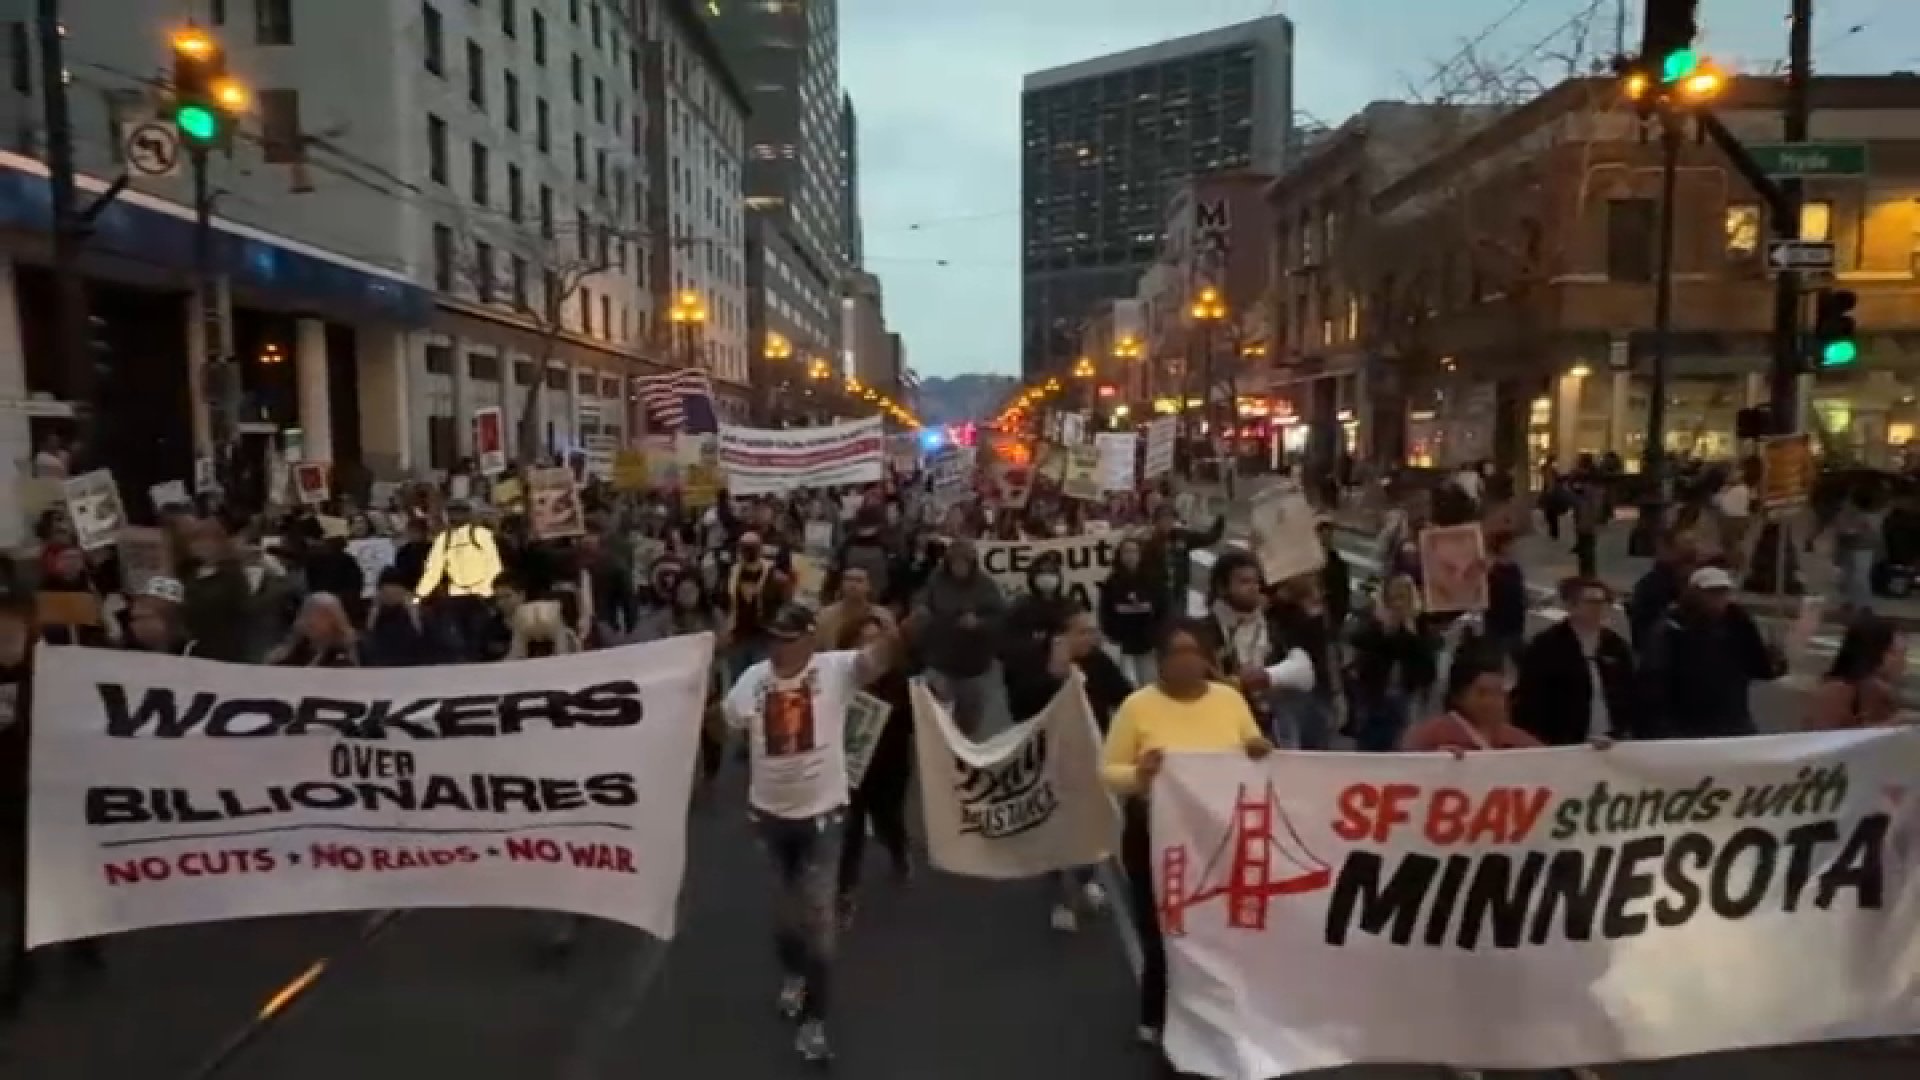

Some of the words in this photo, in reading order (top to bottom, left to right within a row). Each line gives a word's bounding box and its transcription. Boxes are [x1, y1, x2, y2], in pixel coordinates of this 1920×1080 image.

[95, 679, 643, 740] WORKERS
[330, 742, 416, 778] OVER
[85, 772, 638, 824] BILLIONAIRES
[1332, 783, 1413, 844] SF
[1425, 786, 1553, 845] BAY
[1550, 776, 1731, 840] stands
[1732, 763, 1848, 818] with
[105, 856, 169, 885] NO
[183, 847, 276, 878] CUTS
[309, 843, 364, 870] NO
[372, 845, 480, 868] RAIDS
[505, 837, 562, 863] NO
[571, 841, 638, 875] WAR
[1325, 814, 1890, 951] MINNESOTA
